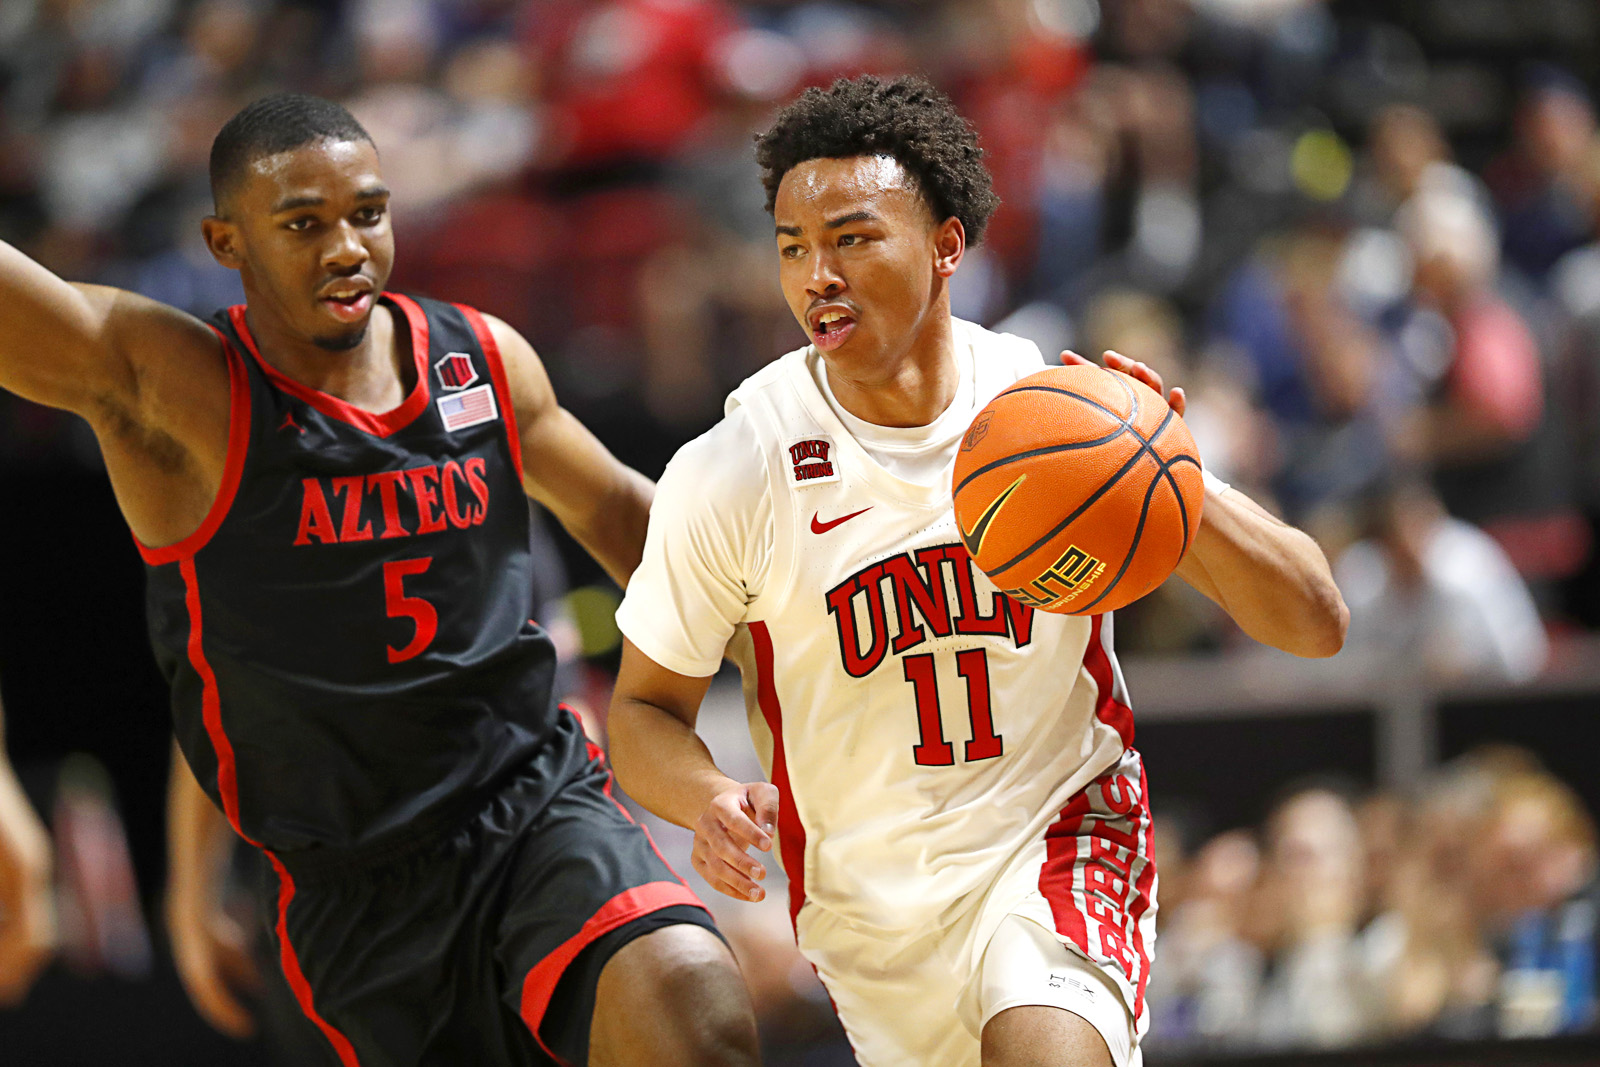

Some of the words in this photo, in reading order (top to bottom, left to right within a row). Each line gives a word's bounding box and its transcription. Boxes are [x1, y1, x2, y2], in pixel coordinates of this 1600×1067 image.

[293, 457, 489, 546] AZTECS
[789, 440, 830, 465] UNLV
[794, 461, 834, 481] STRONG
[383, 556, 438, 664] 5
[902, 647, 1003, 767] 11
[1084, 774, 1142, 982] REBELS
